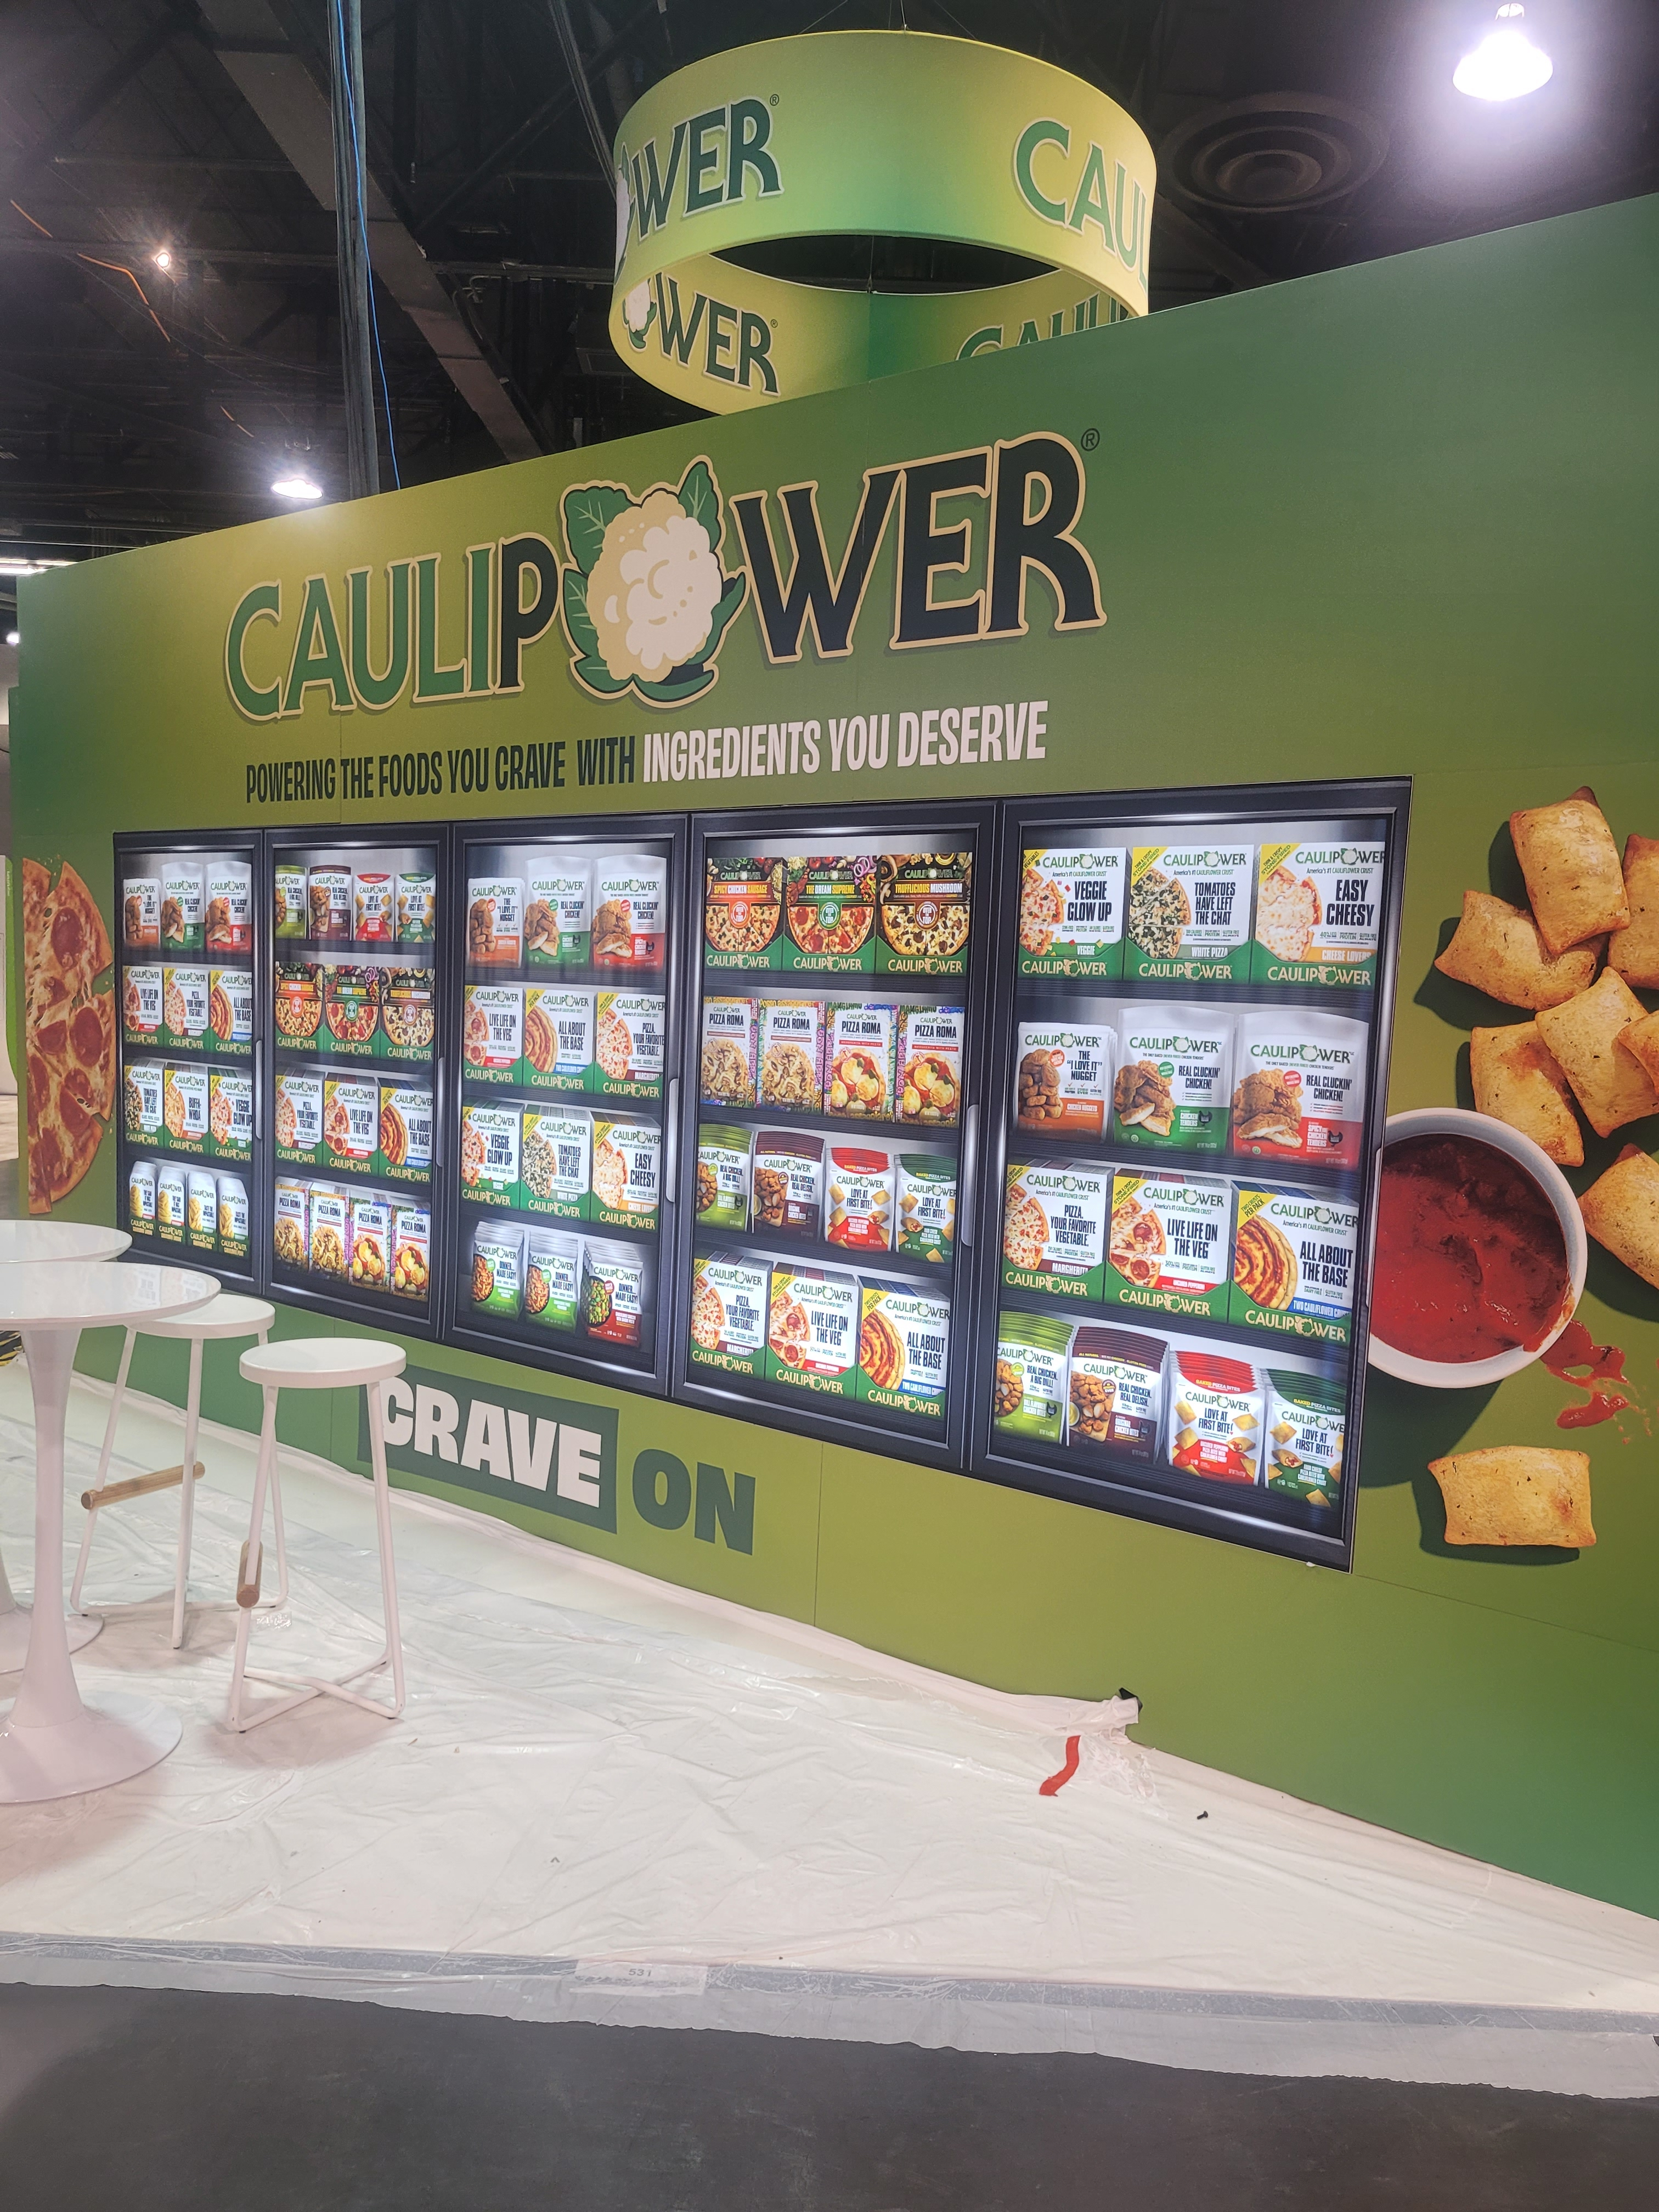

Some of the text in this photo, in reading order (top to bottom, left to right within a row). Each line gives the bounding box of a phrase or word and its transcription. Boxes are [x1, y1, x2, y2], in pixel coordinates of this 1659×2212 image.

[247, 701, 1048, 803] POWERING THE FOODS YOU CRAVE WITH INGREDIENTS YOU DESERVE
[1261, 845, 1290, 874] STONE-FIRED
[714, 885, 727, 893] SPICY
[727, 885, 747, 894] CHICKEN
[806, 885, 855, 894] THE DREAM SUPREME
[895, 883, 962, 893] TRUFFLICIOUS MUSHROOM
[1075, 881, 1107, 900] VEGGIE
[1195, 882, 1235, 896] TOMATOES
[1336, 880, 1368, 901] EASY
[1196, 897, 1233, 910] HAVE LEFT
[1068, 902, 1111, 921] GLOW UP
[1196, 911, 1231, 925] THE CHAT
[1327, 904, 1374, 926] CHEESY
[1077, 945, 1095, 955] VEGGIE
[1192, 947, 1228, 957] WHITE PIZZA
[1322, 950, 1345, 961] CHEESE
[709, 1014, 743, 1026] PIZZA ROMA
[559, 1021, 585, 1036] ALL ABOUT
[915, 1025, 956, 1038] PIZZA ROMA
[560, 1037, 584, 1051] THE BASE
[1079, 1051, 1090, 1060] THE
[1074, 1060, 1089, 1070] LOVE
[1178, 1065, 1192, 1076] REAL
[1071, 1071, 1097, 1081] NUGGET
[1306, 1075, 1321, 1086] REAL
[1186, 1078, 1212, 1090] CHICKEN!
[1314, 1088, 1343, 1102] CHICKEN!
[417, 1120, 431, 1133] ABOUT
[491, 1133, 509, 1150] VEGGIE
[488, 1149, 512, 1166] GLOW UP
[635, 1153, 651, 1170] EASY
[630, 1170, 656, 1188] CHEESY
[851, 1188, 868, 1199] LOVE AT
[847, 1198, 860, 1207] FIRST
[1245, 1199, 1265, 1217] PER PACK
[359, 1212, 370, 1223] PIZZA
[1064, 1205, 1083, 1218] PIZZA.
[1051, 1216, 1096, 1234] YOUR FAVORITE
[1167, 1218, 1217, 1242] LIVE LIFE ON
[1056, 1230, 1089, 1246] VEGETABLE.
[1175, 1238, 1209, 1259] THE VEG
[1300, 1241, 1353, 1268] ALL ABOUT
[1303, 1262, 1348, 1288] THE BASE
[1293, 1300, 1333, 1317] TWO CAULIFLOWER
[907, 1331, 945, 1353] ALL ABOUT
[909, 1348, 941, 1370] THE BASE
[1028, 1365, 1037, 1374] REAL
[1030, 1375, 1035, 1383] A
[1043, 1377, 1053, 1387] DILL!
[1119, 1383, 1152, 1398] REAL CHICKEN.
[1120, 1393, 1149, 1407] REAL DELISH.
[1205, 1408, 1228, 1421] LOVE AT
[1199, 1418, 1216, 1431] FIRST
[1302, 1428, 1328, 1444] LOVE AT
[1296, 1438, 1314, 1453] FIRST
[383, 1377, 756, 1555] CRAVE ON
